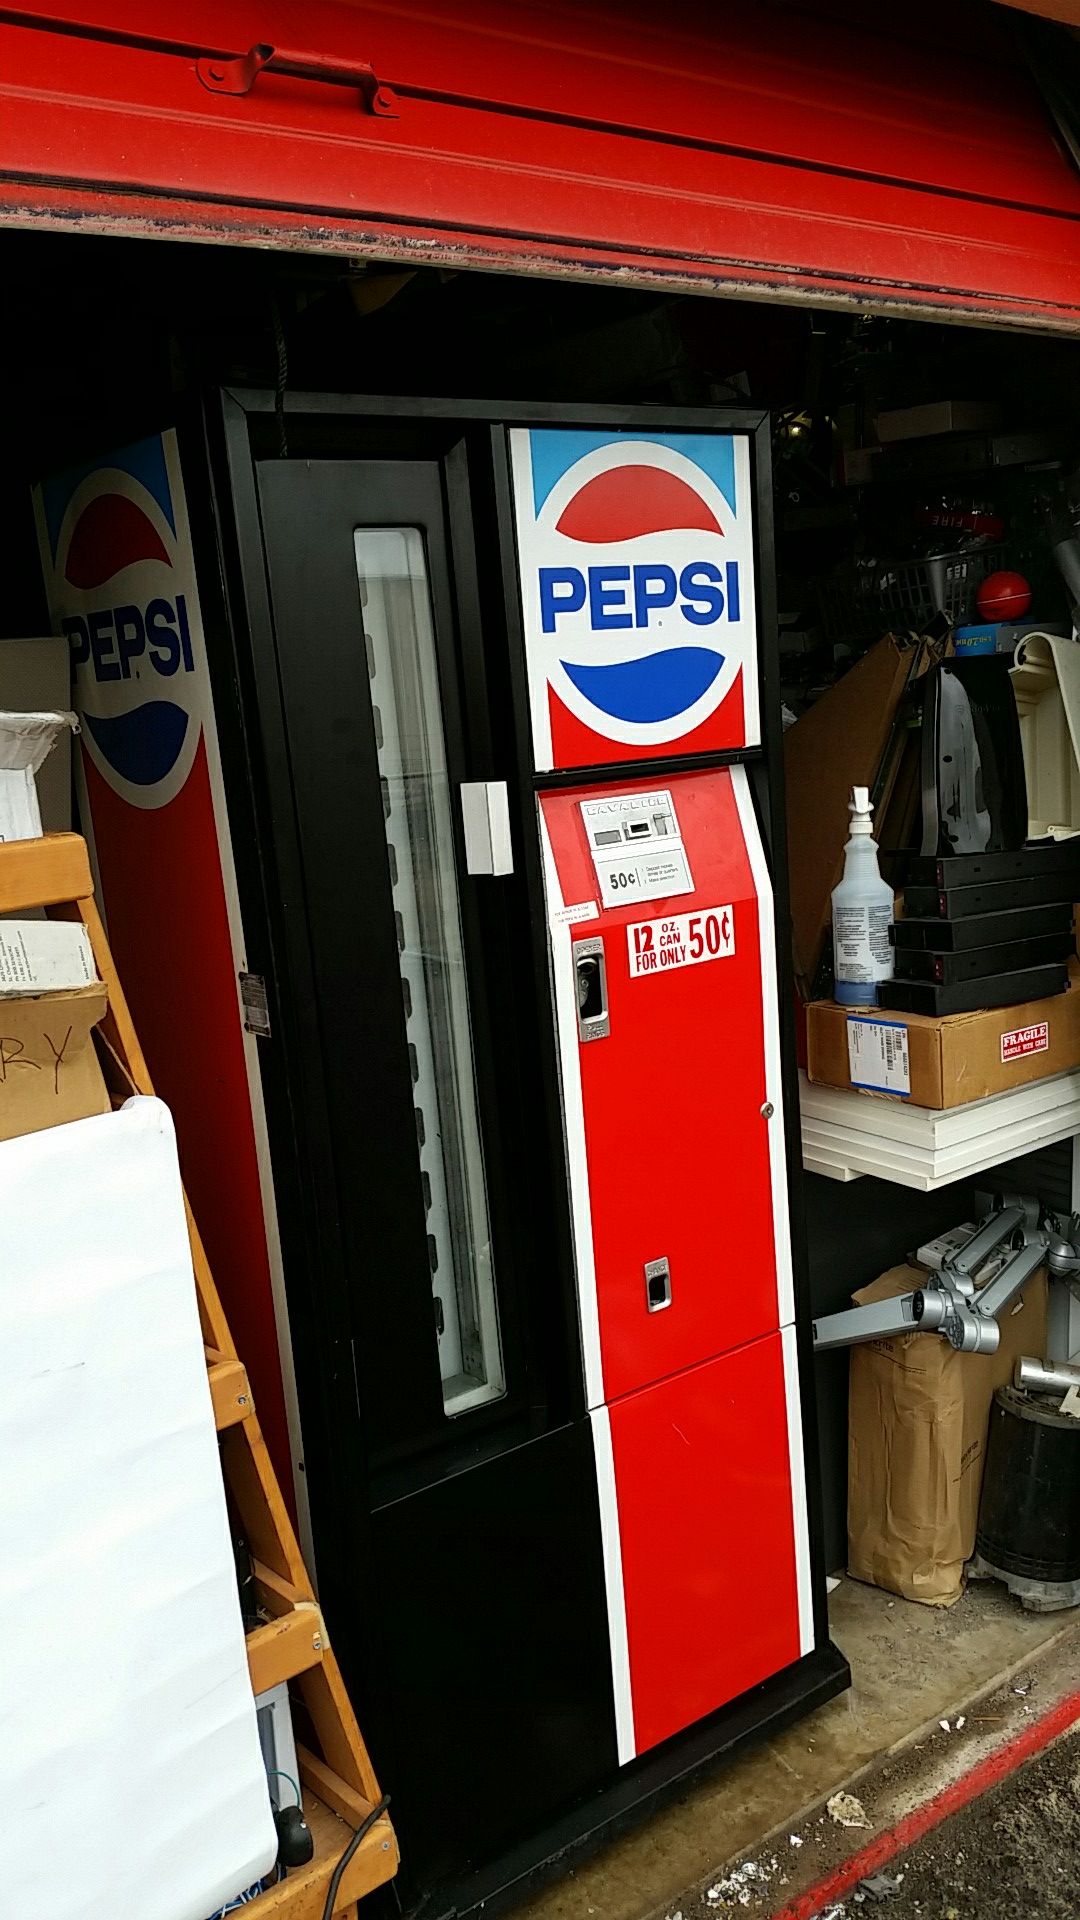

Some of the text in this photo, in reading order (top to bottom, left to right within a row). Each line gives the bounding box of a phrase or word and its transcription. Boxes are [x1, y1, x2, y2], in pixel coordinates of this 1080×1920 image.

[538, 561, 740, 633] PEPSI
[62, 595, 194, 684] PEPSI
[610, 872, 636, 890] 50¢
[634, 922, 680, 953] 12 OZ.
[659, 932, 681, 946] CAN
[689, 911, 731, 959] 50¢
[636, 945, 686, 972] FOR ONLY
[1004, 1026, 1046, 1048] FRAGILE
[1004, 1038, 1046, 1056] HANDLE WITH CARE
[0, 1026, 72, 1094] RY
